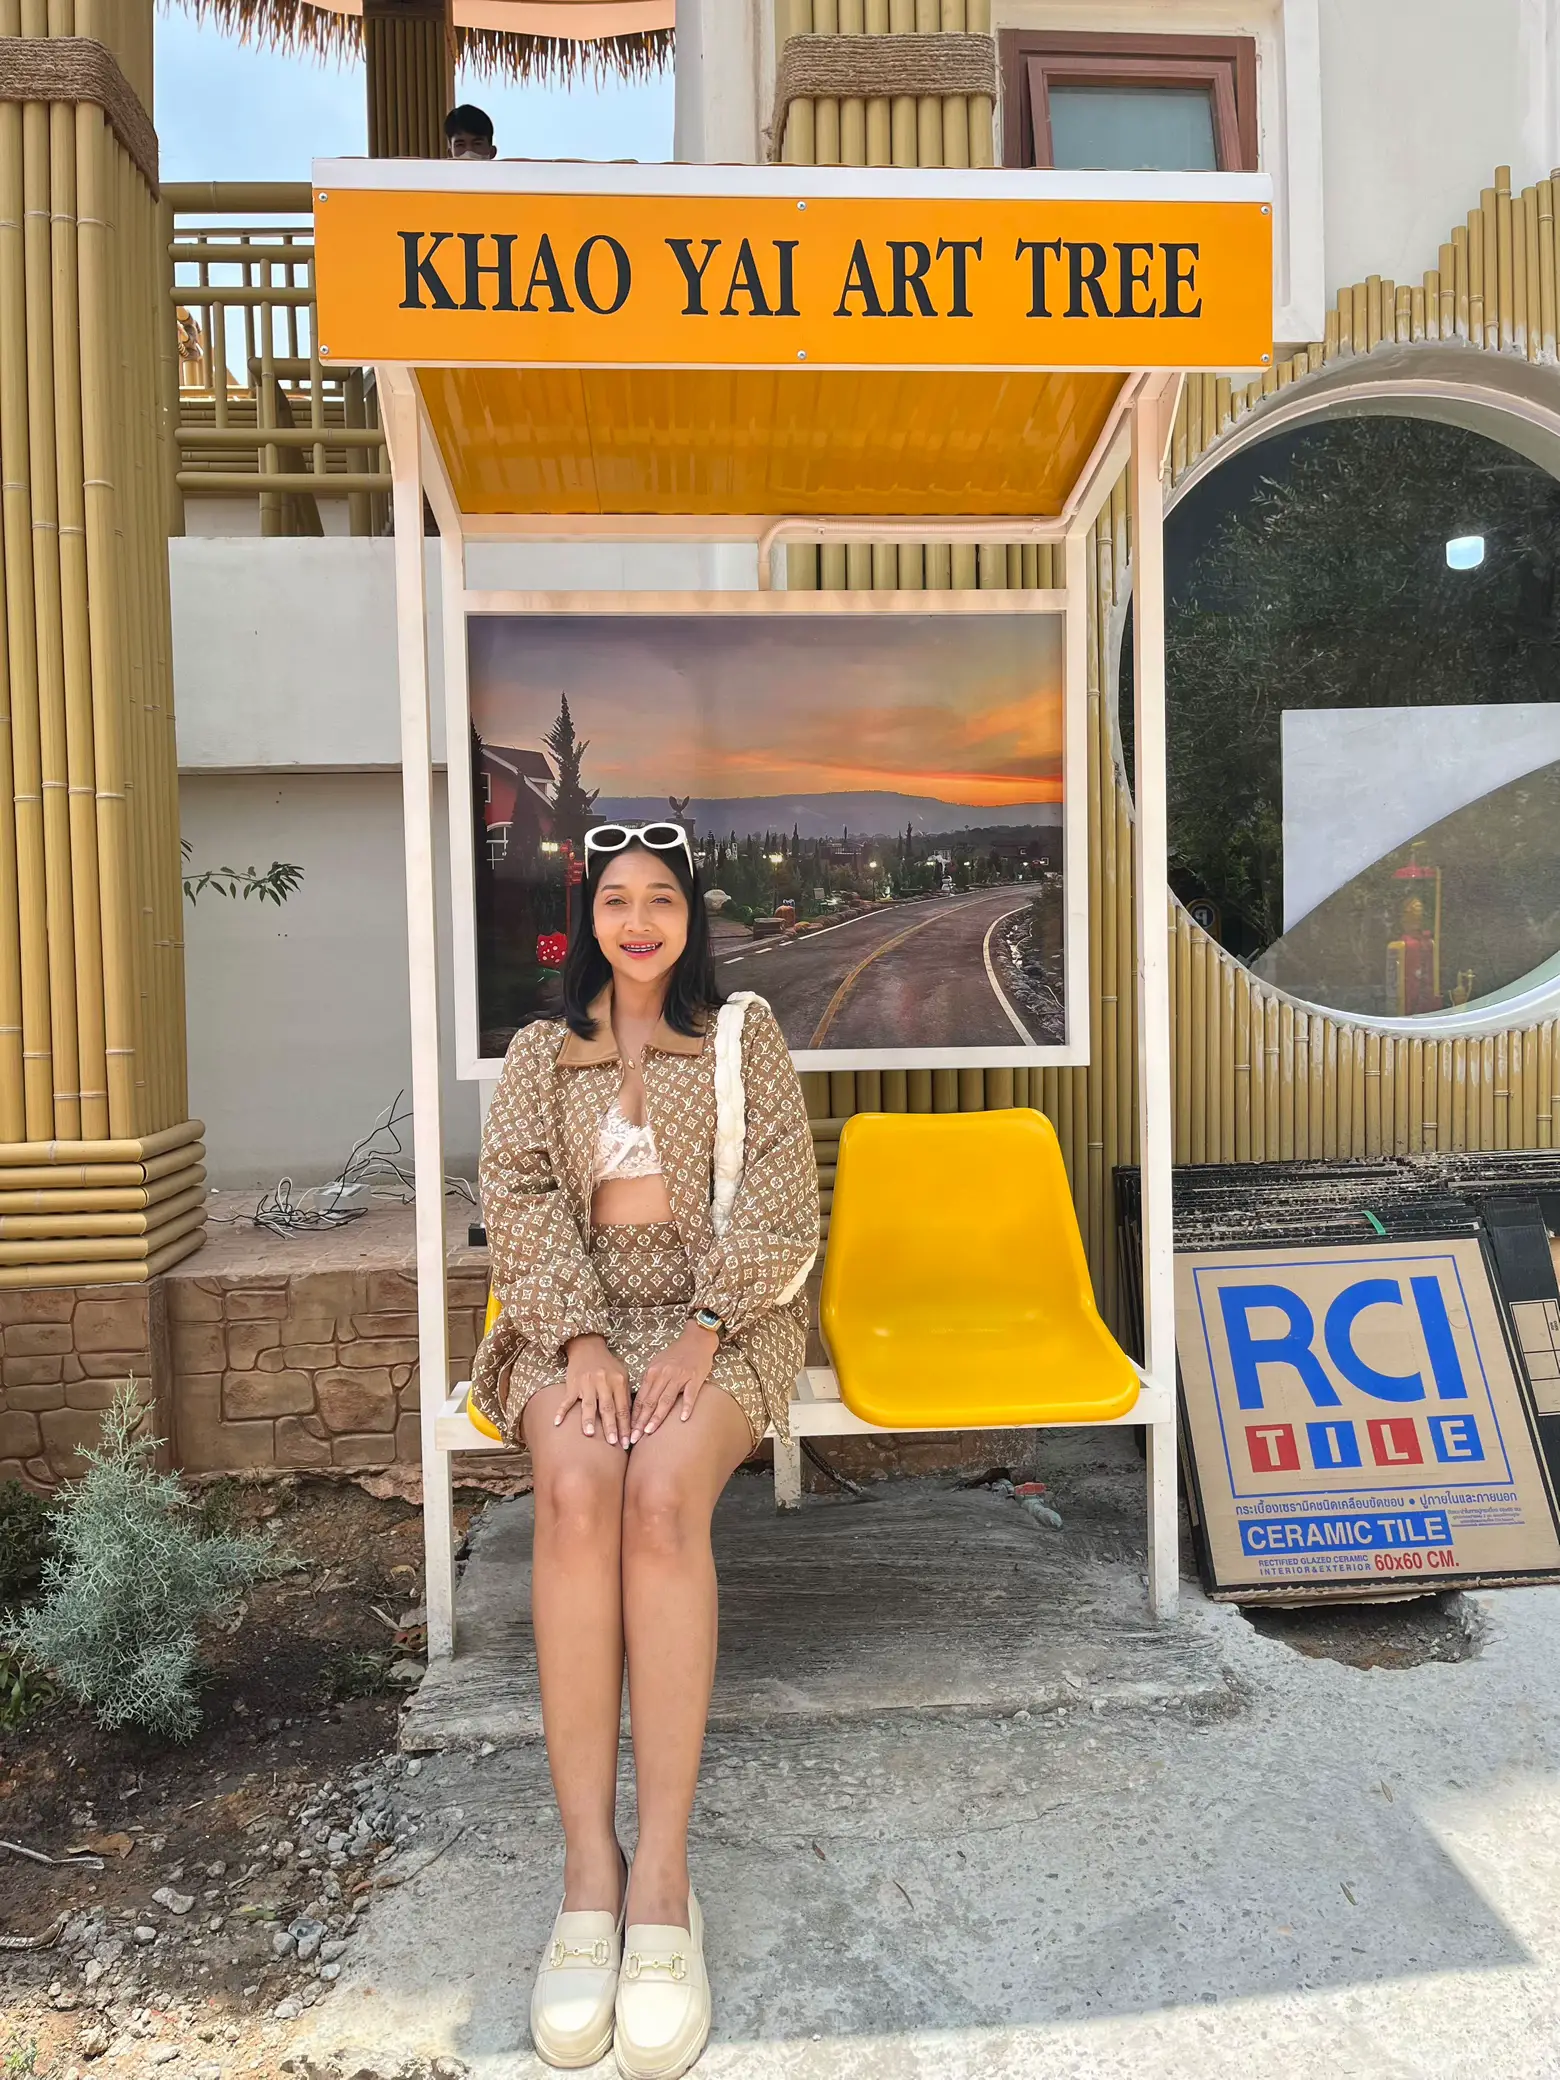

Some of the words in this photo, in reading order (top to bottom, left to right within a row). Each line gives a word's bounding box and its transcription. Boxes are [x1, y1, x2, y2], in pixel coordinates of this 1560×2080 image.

[397, 231, 632, 315] KHAO
[665, 238, 801, 317] YAI
[833, 237, 983, 318] ART
[1015, 237, 1202, 318] TREE
[1217, 1275, 1469, 1410] RCI
[1255, 1419, 1473, 1468] TILE
[1246, 1520, 1373, 1550] CERAMIC
[1377, 1516, 1447, 1542] TILE
[1258, 1558, 1299, 1567] RECTIFIED
[1300, 1556, 1332, 1565] GLAZED
[1333, 1554, 1369, 1563] CERAMIC
[1374, 1551, 1423, 1571] 60x60
[1426, 1549, 1460, 1568] CM.
